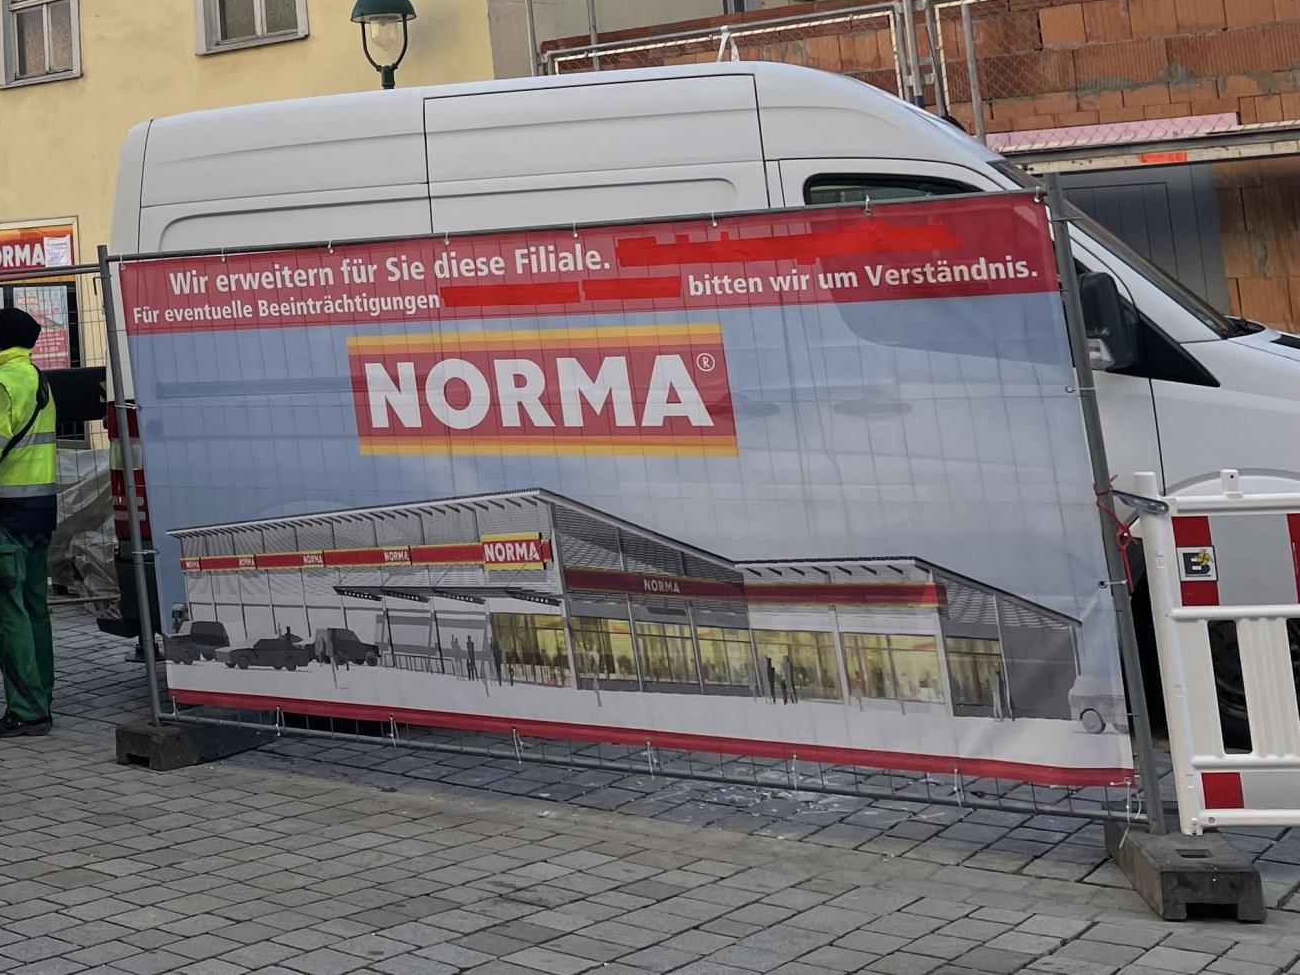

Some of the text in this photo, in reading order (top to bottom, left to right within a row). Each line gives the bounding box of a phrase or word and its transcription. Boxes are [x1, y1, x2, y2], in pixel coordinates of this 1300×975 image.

[169, 243, 610, 295] Wir erweitern für Sie diese Filiale.
[133, 255, 1038, 324] Für eventuelle Beeinträchtigungen bitten wir um Verständnis.
[365, 354, 714, 430] NORMA
[303, 553, 323, 565] NORMA
[384, 549, 410, 562] NORMA
[484, 541, 540, 562] NORMA
[644, 578, 681, 593] NORMA
